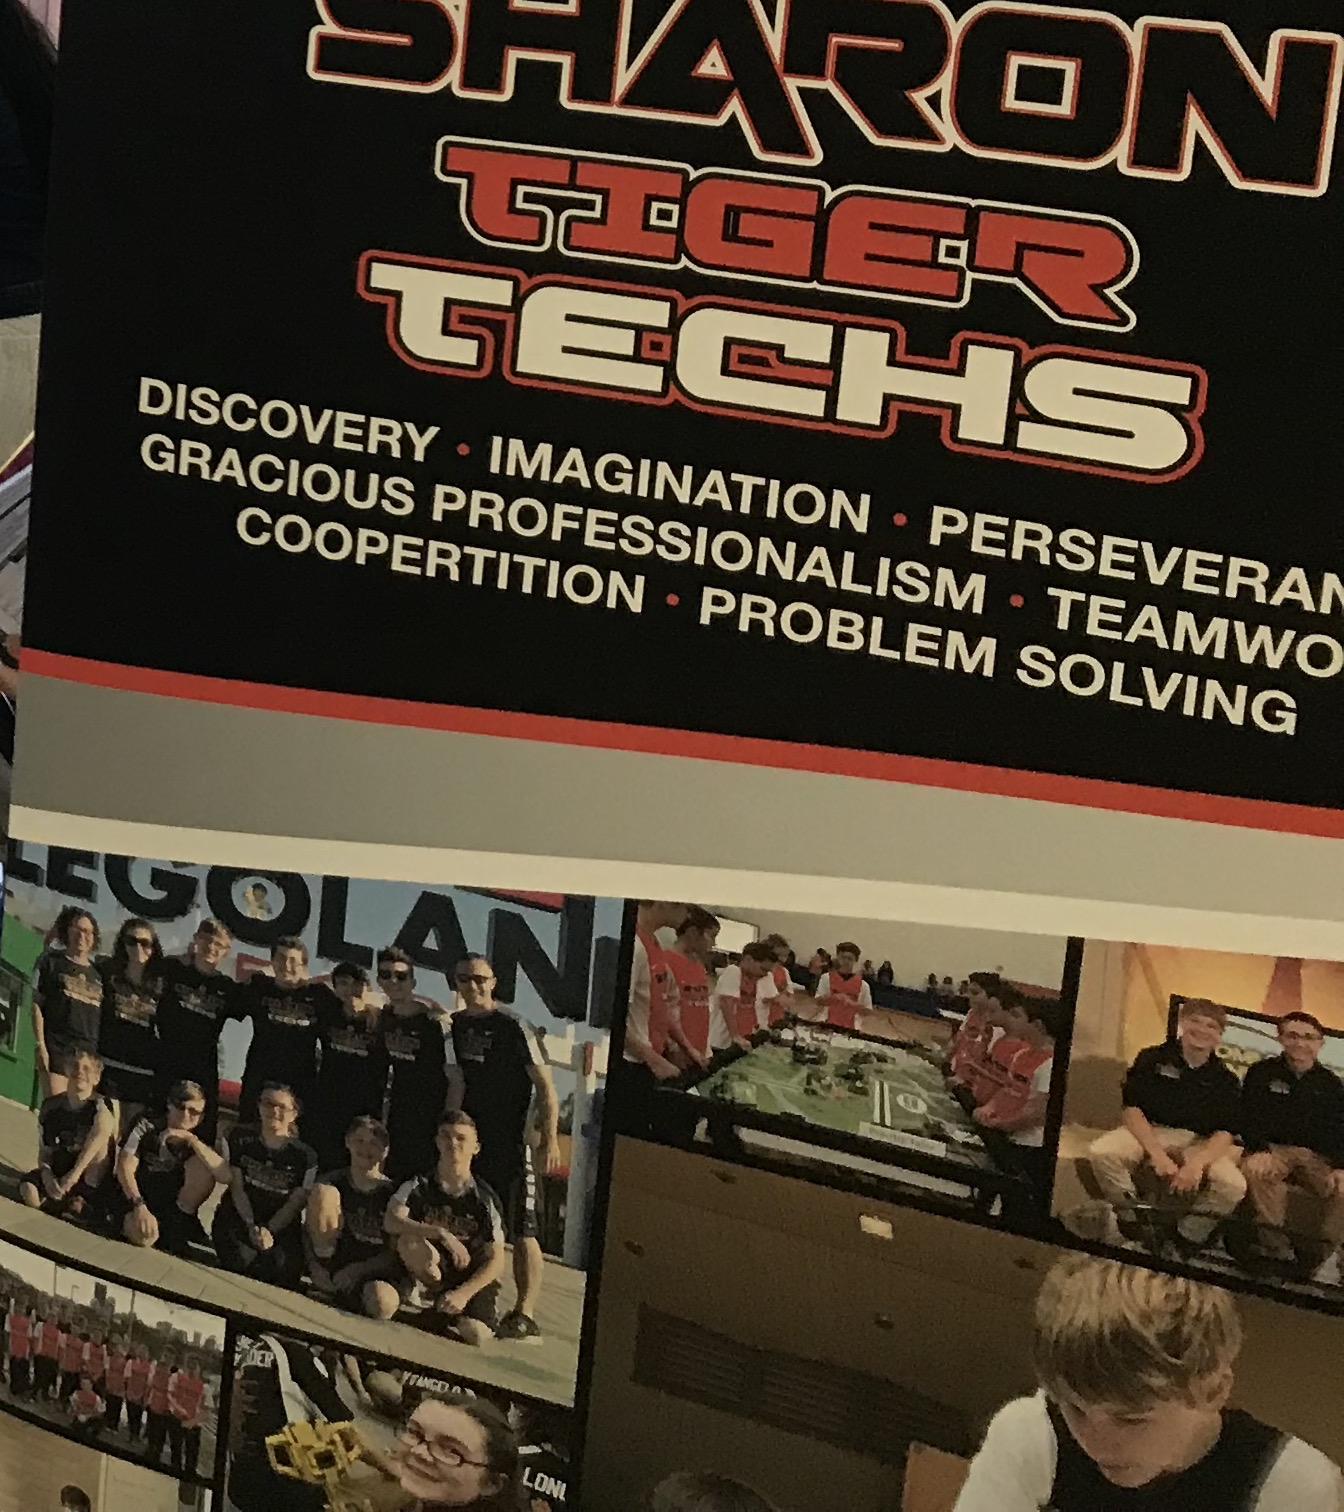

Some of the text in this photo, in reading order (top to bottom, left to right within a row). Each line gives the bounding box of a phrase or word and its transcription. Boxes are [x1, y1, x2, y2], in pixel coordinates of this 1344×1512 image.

[435, 136, 1138, 332] TIGER
[138, 377, 440, 462] DISCOVERY
[489, 435, 871, 534] IMAGINATION
[358, 249, 1207, 484] TECHS
[140, 433, 1344, 678] GRACIOUS PROFESSIONALISM TEAMWO
[236, 506, 1297, 736] COOPERTITION PROBLEM SOLVING
